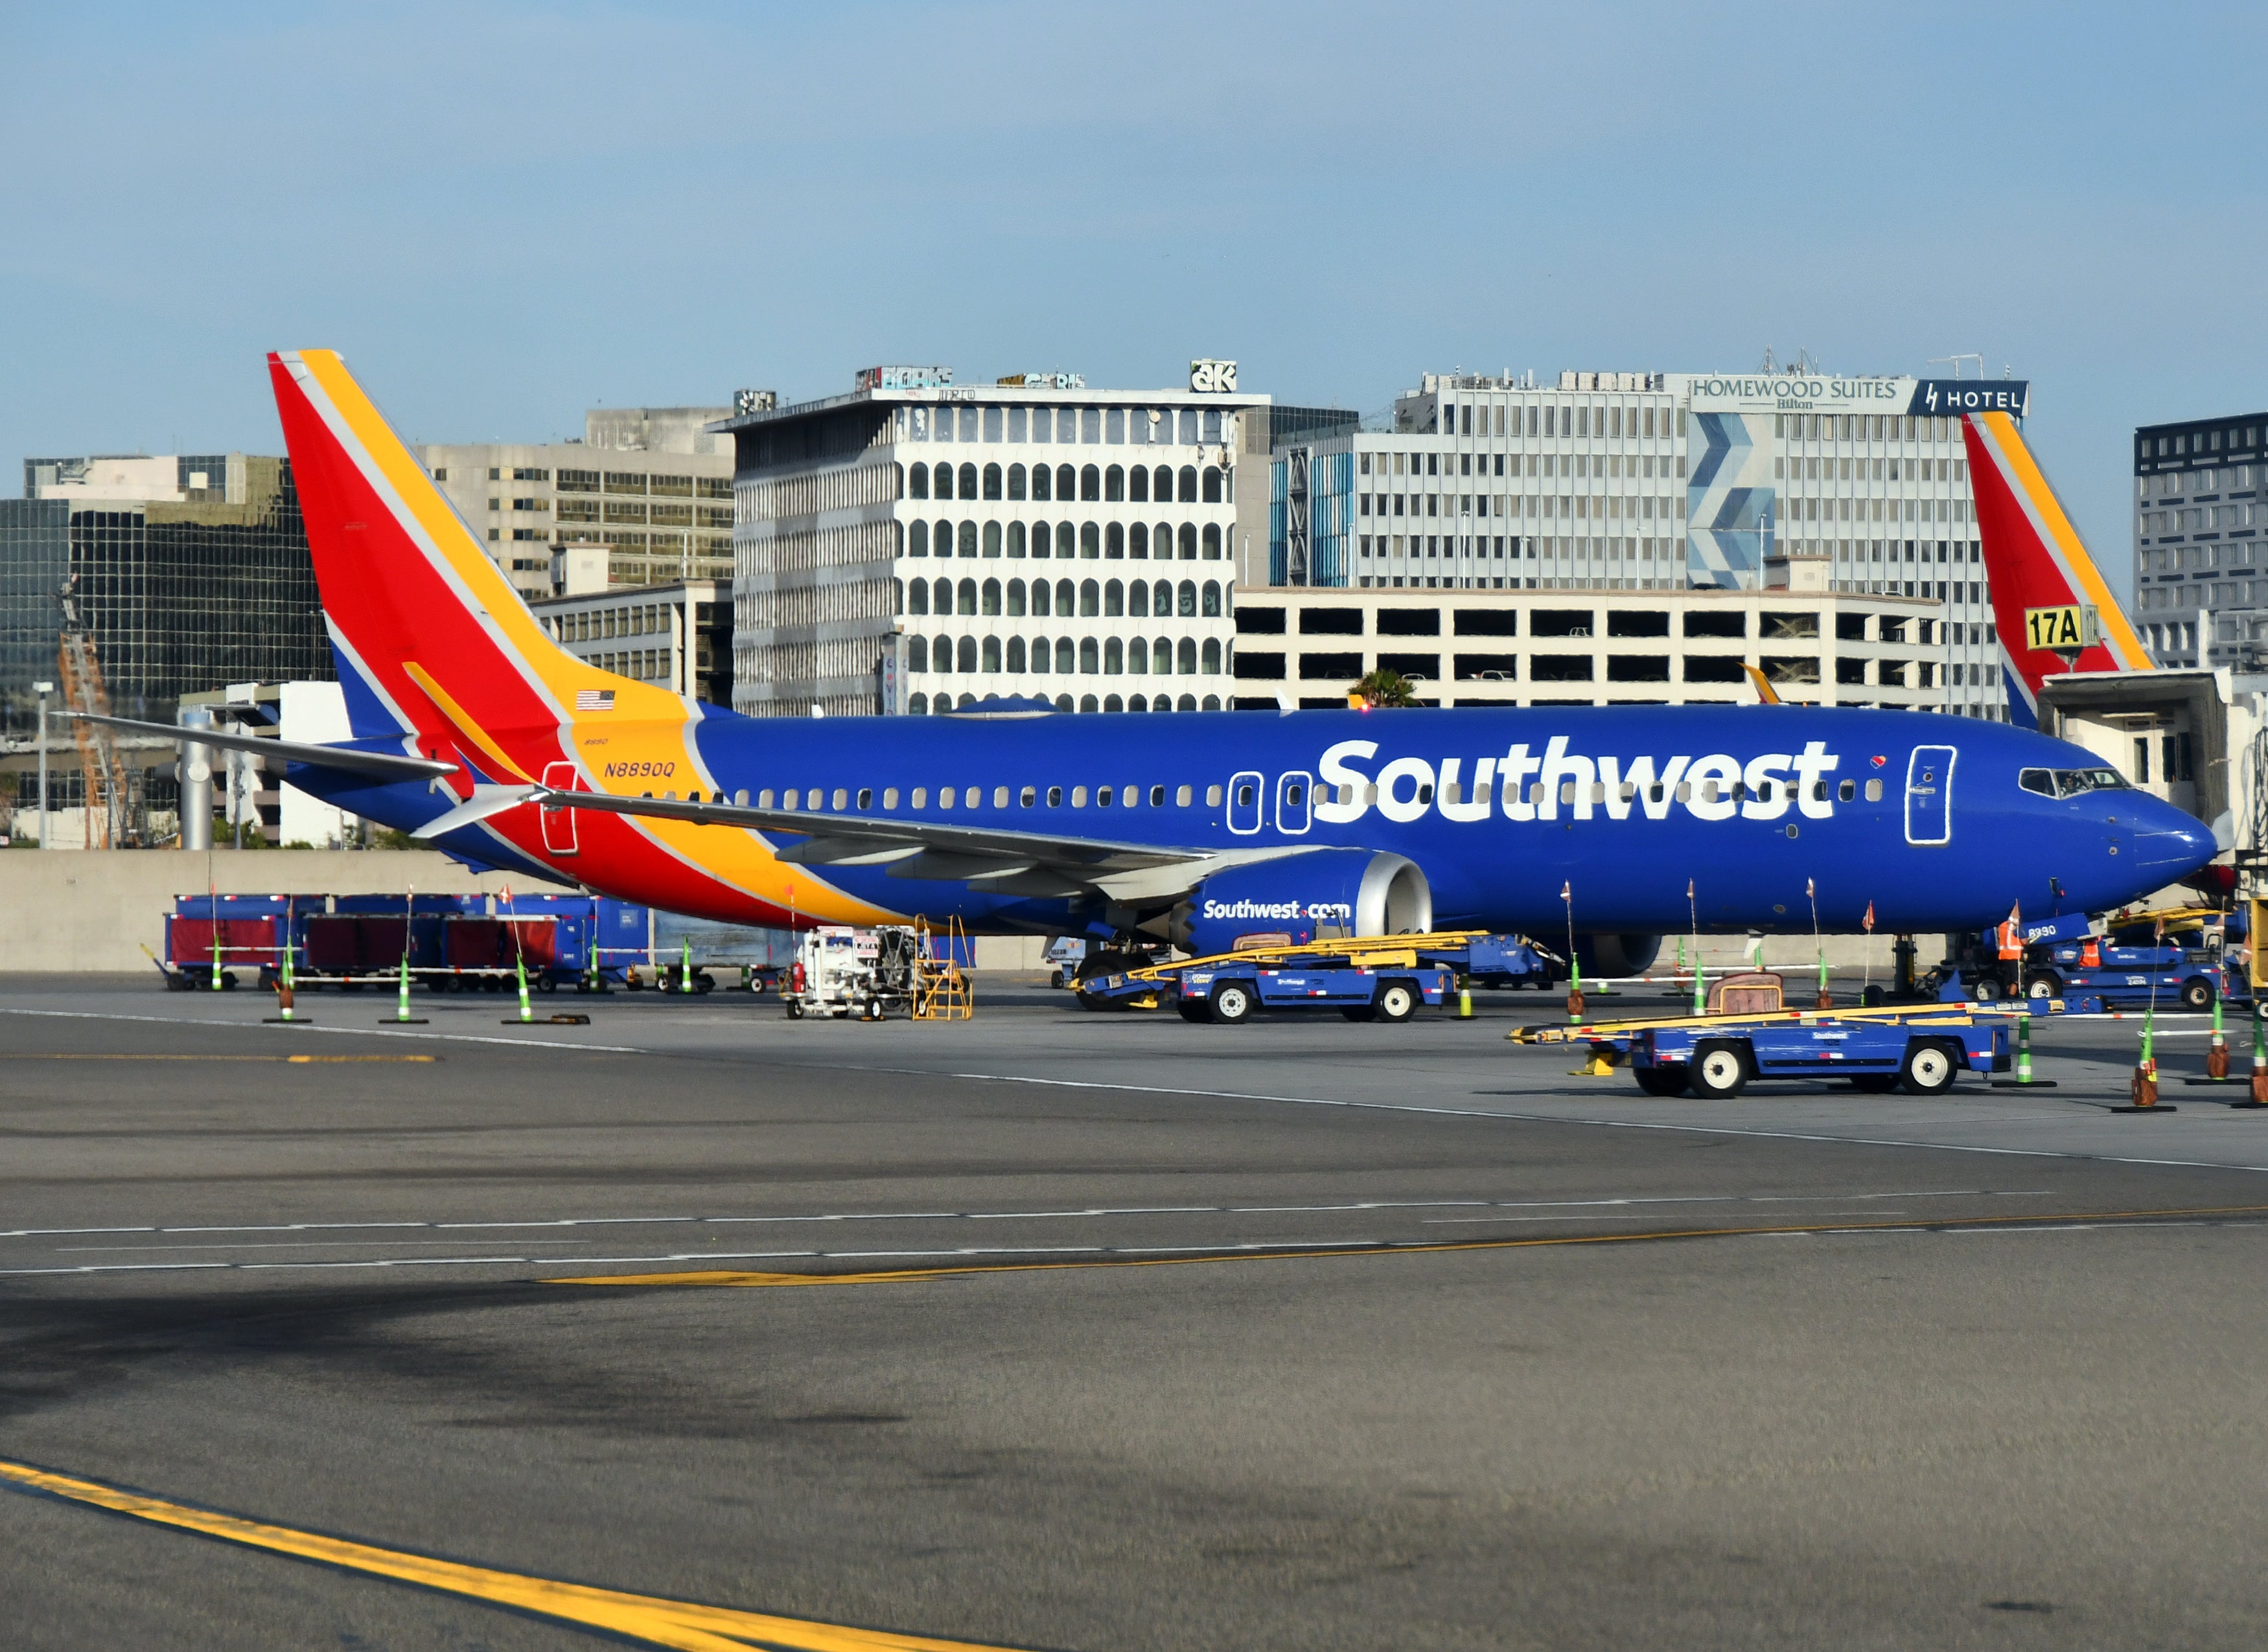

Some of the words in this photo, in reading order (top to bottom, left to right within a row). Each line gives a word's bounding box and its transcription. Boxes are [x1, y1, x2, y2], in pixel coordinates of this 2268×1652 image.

[1693, 380, 1823, 398] HOMEWOOD
[1831, 380, 1897, 399] SUITES
[1777, 398, 1814, 409] Hilton
[1947, 391, 2021, 407] HOTEL
[2030, 609, 2079, 645] 17A
[604, 761, 675, 777] N8890Q
[1313, 735, 1840, 823] Southwest
